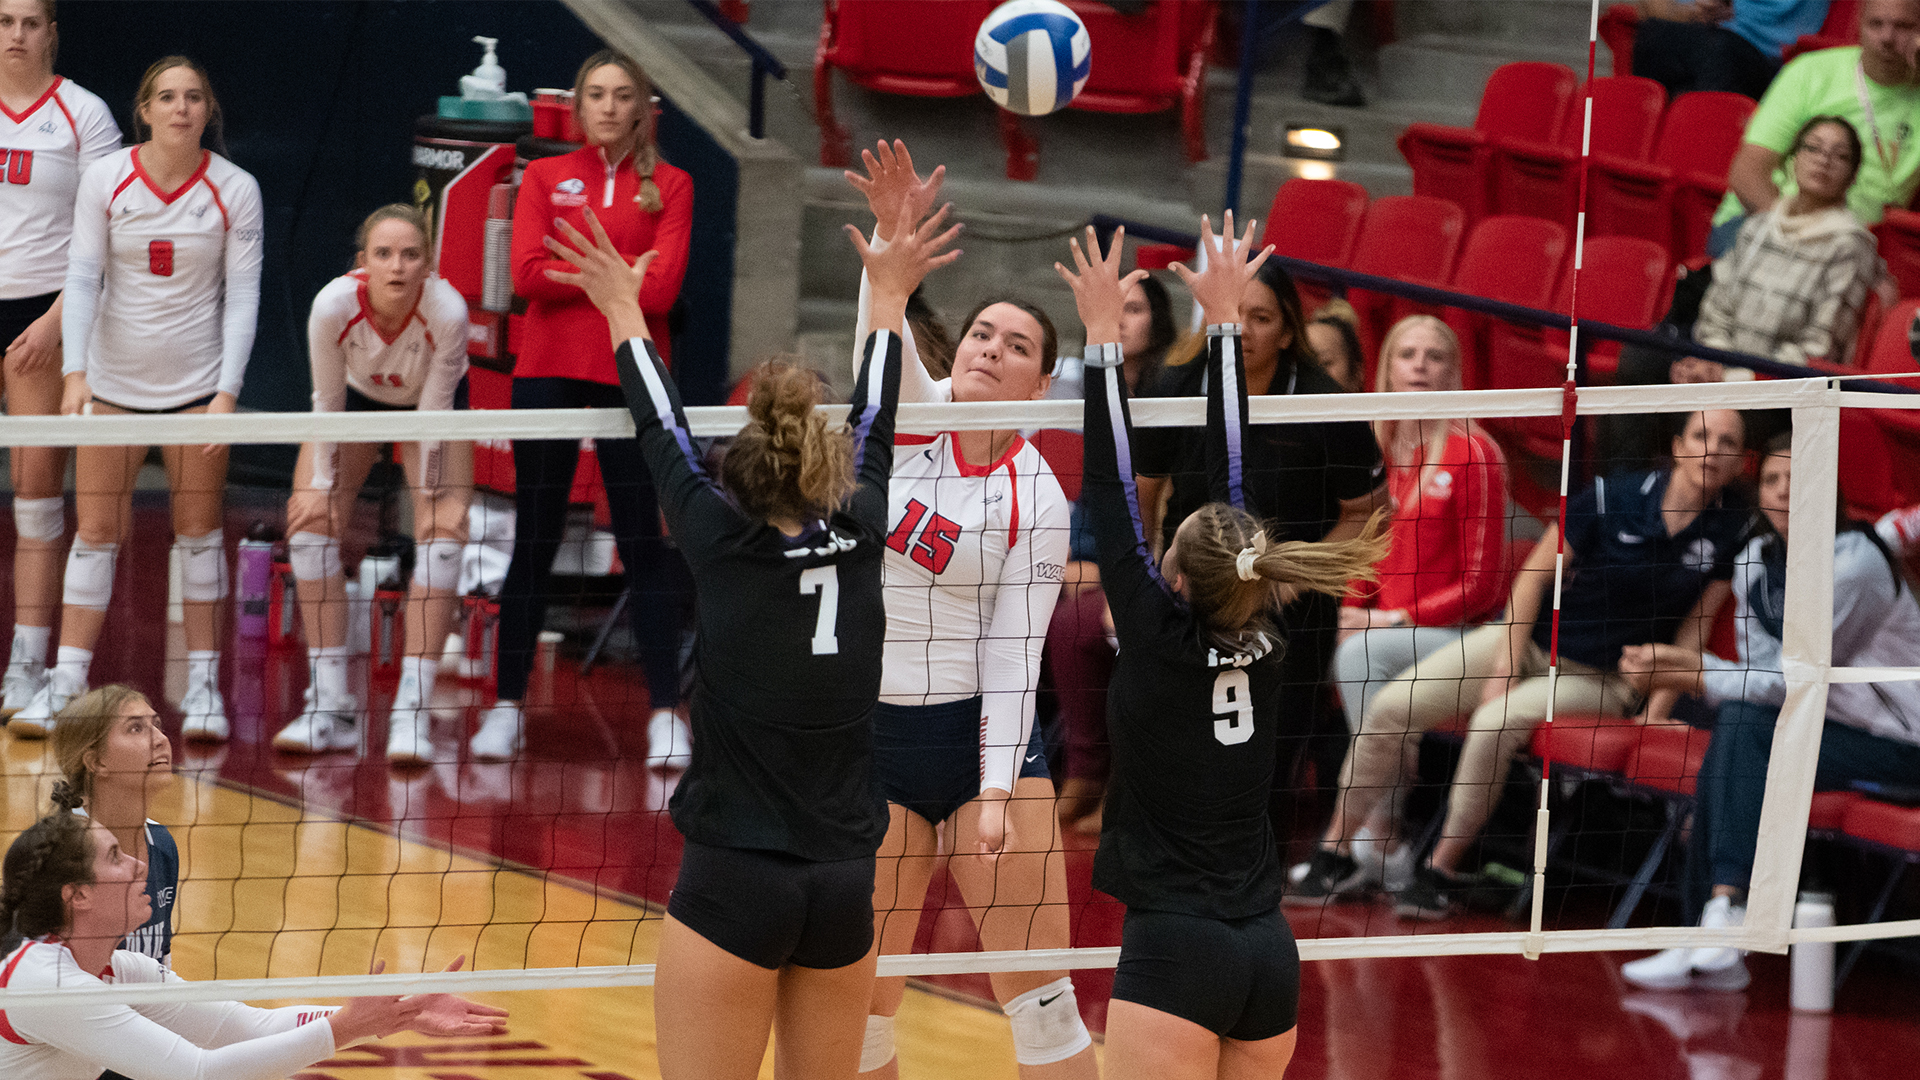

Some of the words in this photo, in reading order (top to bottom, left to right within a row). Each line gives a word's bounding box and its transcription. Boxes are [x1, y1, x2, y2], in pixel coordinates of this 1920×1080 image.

[886, 497, 963, 576] 15
[799, 564, 839, 655] 7
[1212, 668, 1255, 746] 9
